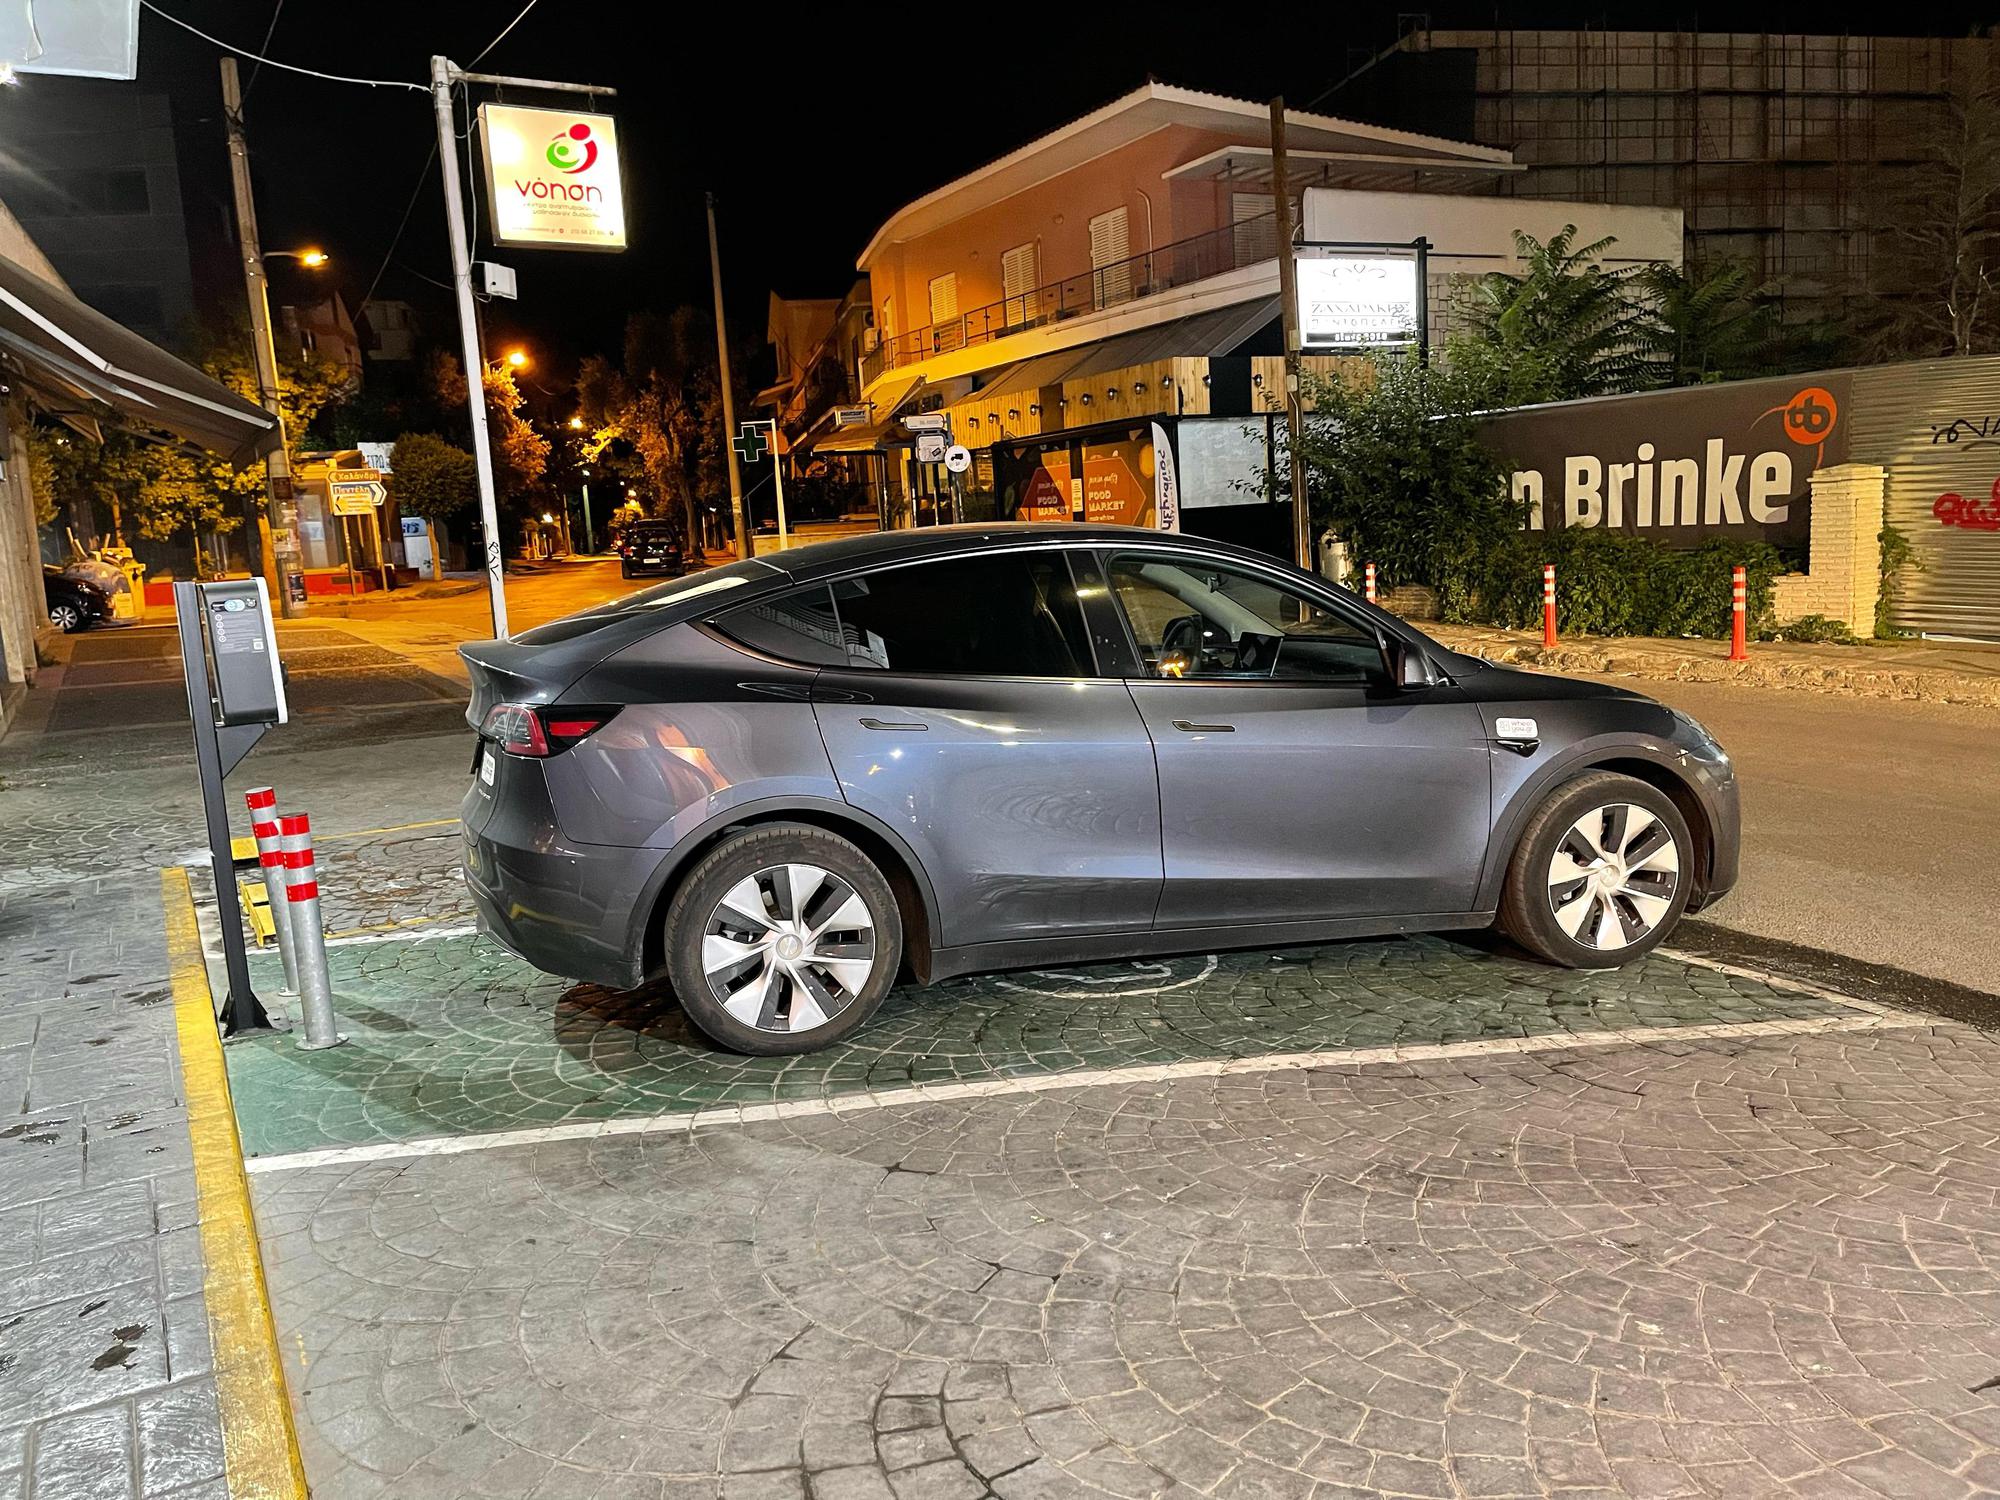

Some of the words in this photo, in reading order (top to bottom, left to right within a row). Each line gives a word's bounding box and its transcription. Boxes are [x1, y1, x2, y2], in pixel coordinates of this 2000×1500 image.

[1564, 438, 1793, 530] Brinke
[1088, 489, 1112, 501] FOOD
[1088, 500, 1125, 512] MARKET
